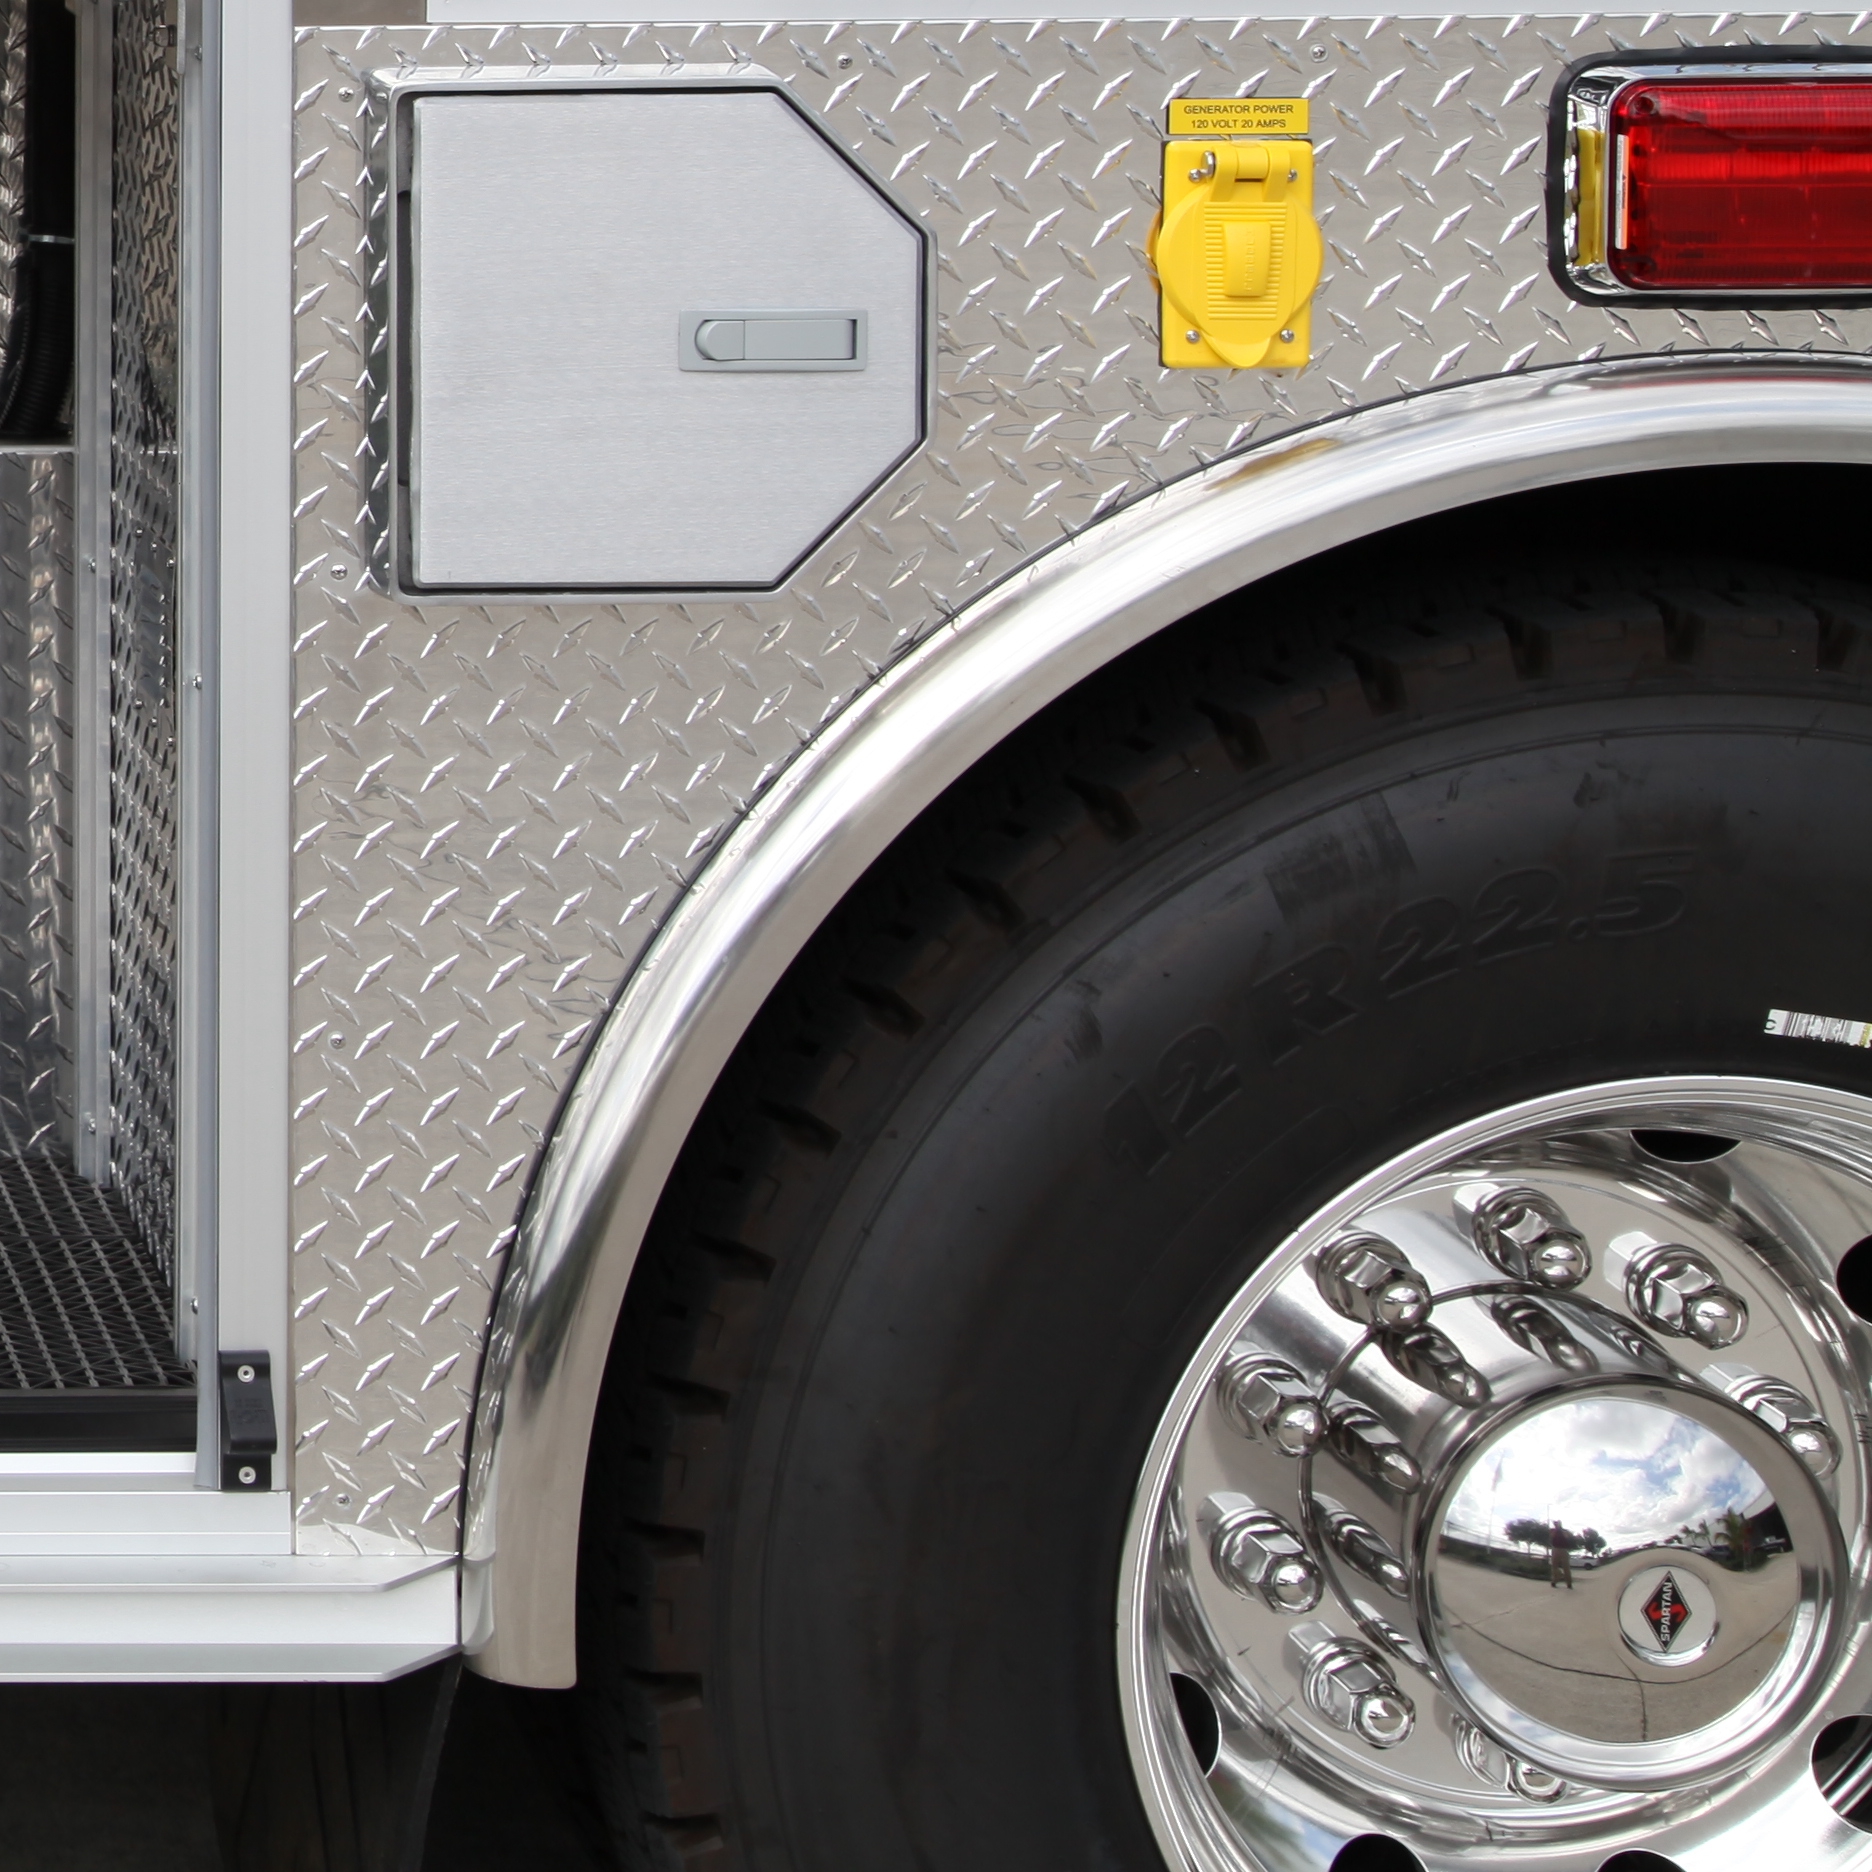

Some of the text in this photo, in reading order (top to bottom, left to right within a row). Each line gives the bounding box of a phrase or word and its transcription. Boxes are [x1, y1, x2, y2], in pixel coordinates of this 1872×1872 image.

[1183, 104, 1294, 115] GENERATOR POWER
[1191, 118, 1287, 129] 120 VOLT 20 AMPS
[1660, 1581, 1673, 1642] SPARTAN
